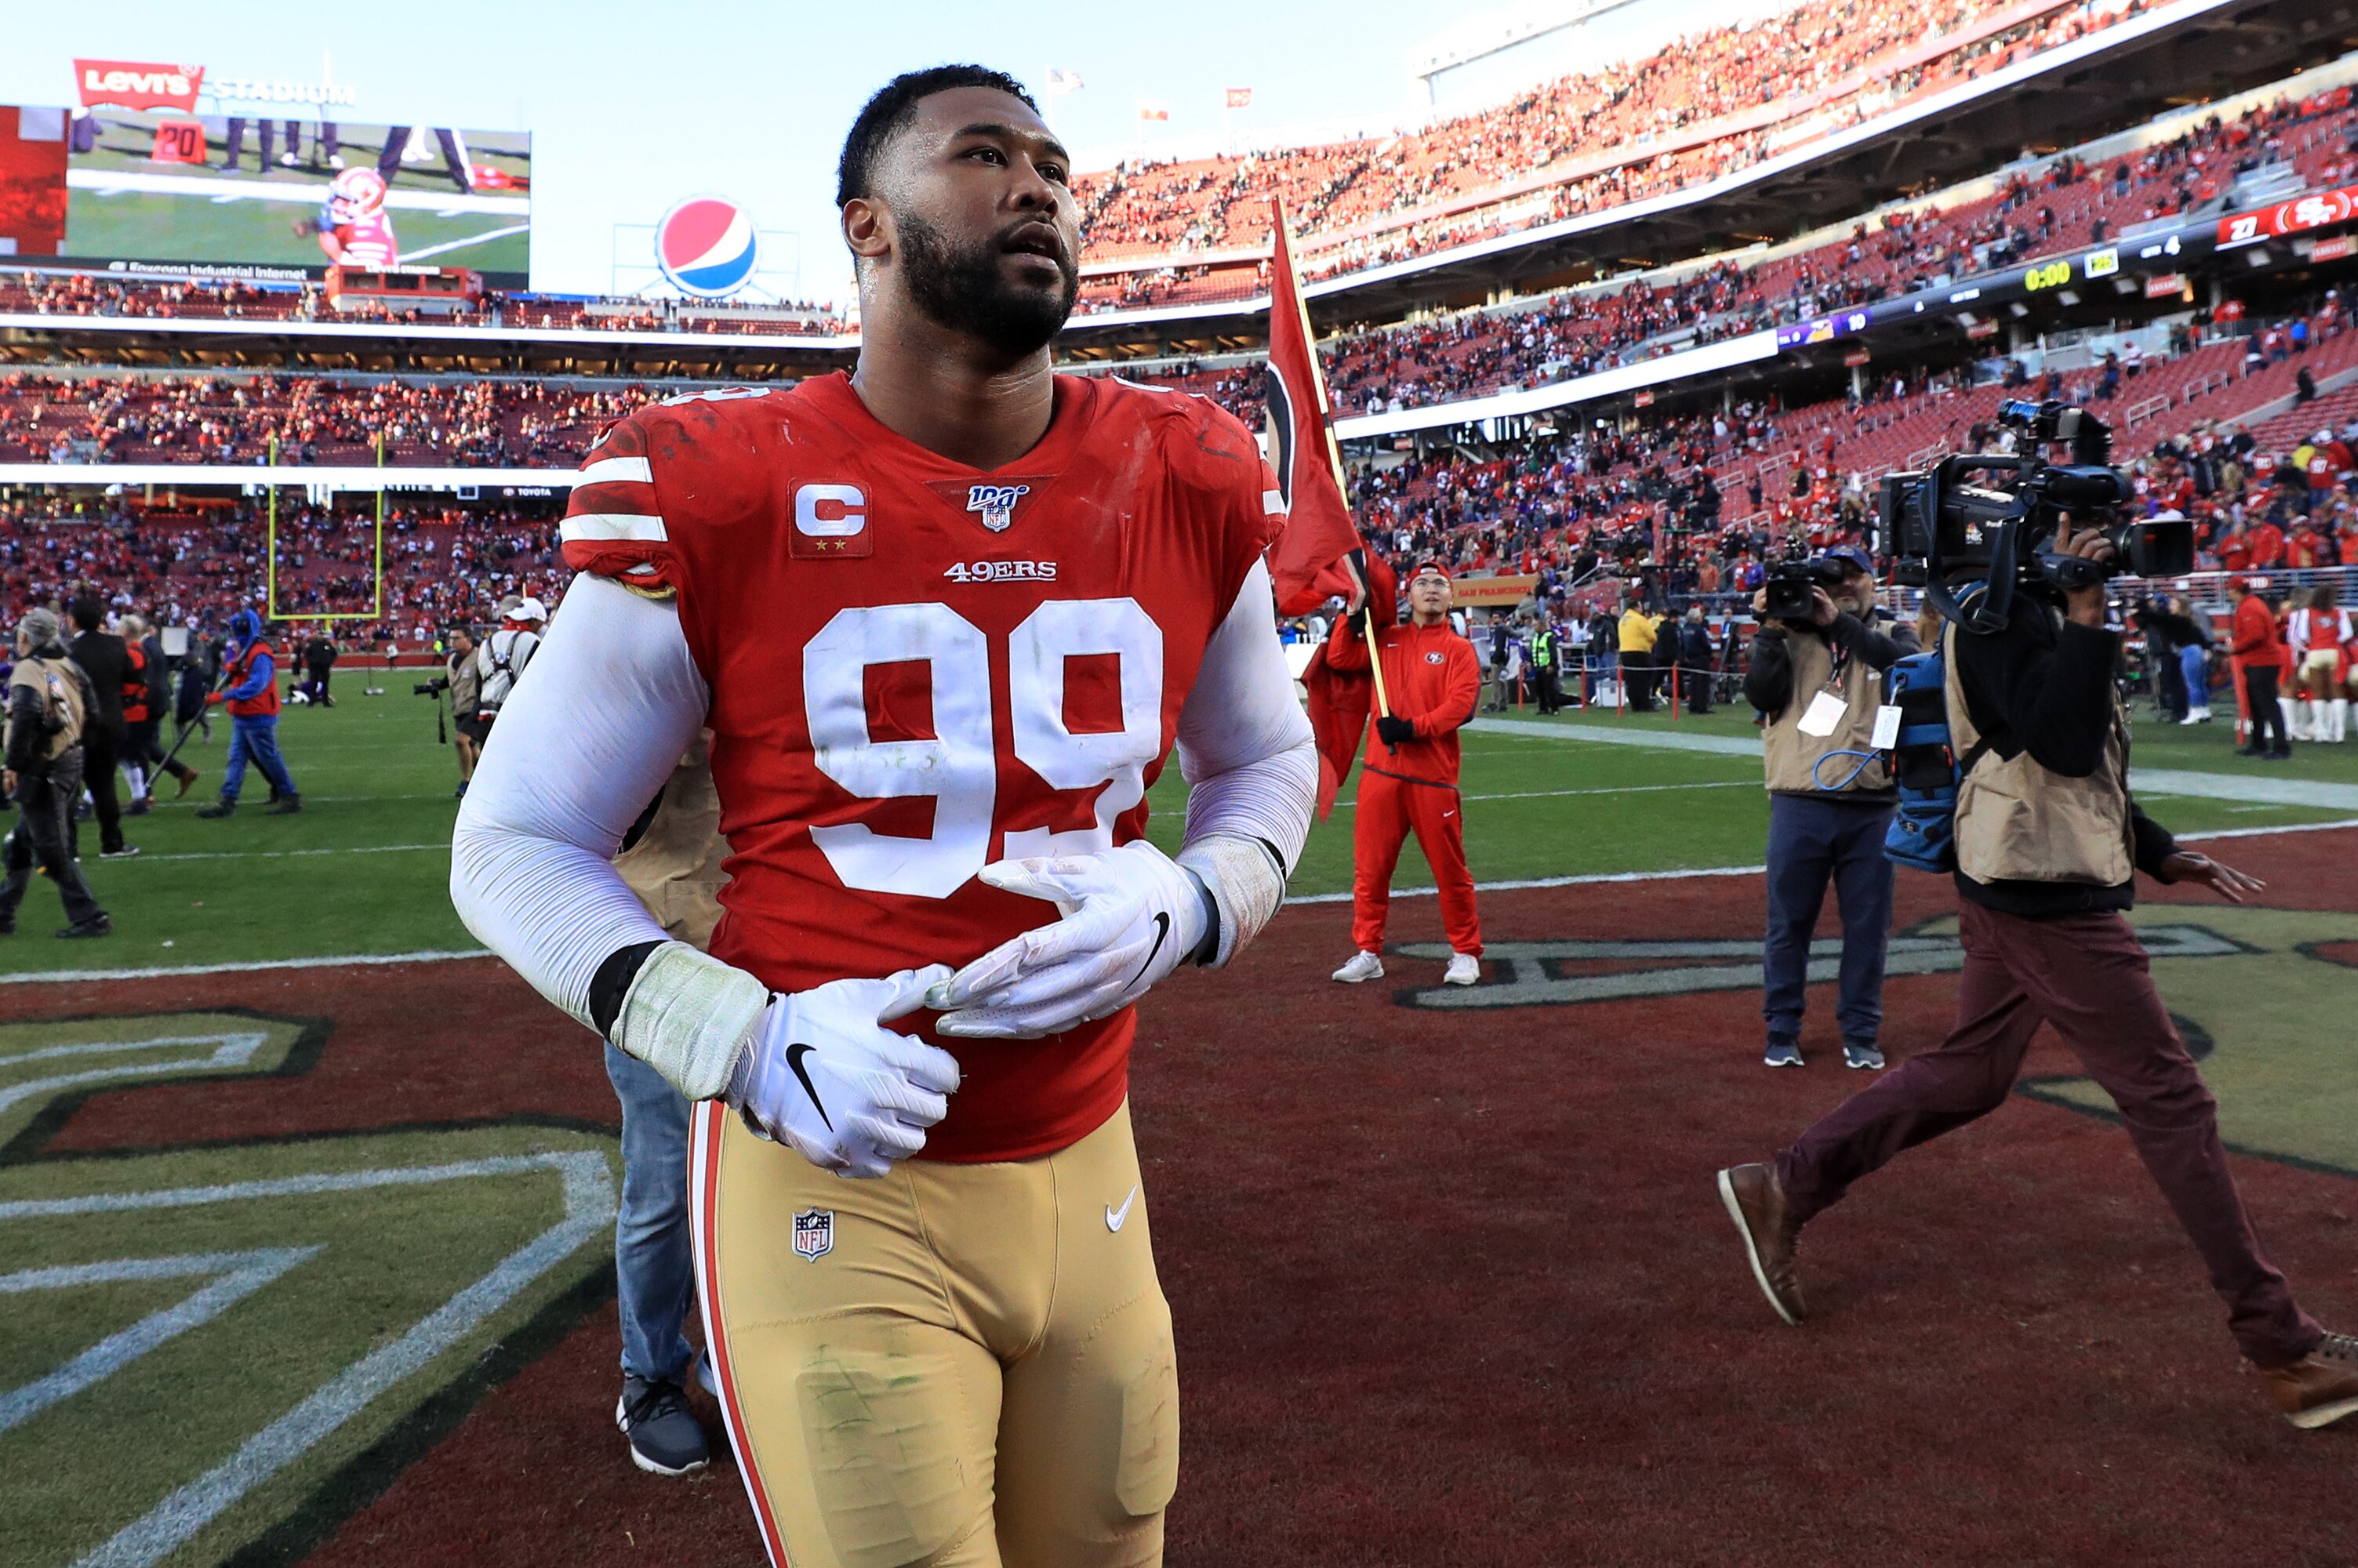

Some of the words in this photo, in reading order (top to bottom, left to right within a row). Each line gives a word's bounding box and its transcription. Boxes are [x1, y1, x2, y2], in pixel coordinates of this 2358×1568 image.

[213, 78, 354, 105] STADIUM
[163, 126, 197, 158] 20
[2229, 216, 2258, 241] 27
[2164, 235, 2181, 255] 4
[129, 261, 189, 274] Foxconn
[190, 263, 254, 277] Industrial
[255, 266, 307, 280] Internet
[2025, 261, 2070, 291] 0:00
[1848, 313, 1866, 331] 10
[518, 488, 551, 496] TOYOTA
[795, 484, 866, 536] C
[988, 514, 1005, 525] NFL
[943, 561, 1057, 583] 49ERS
[803, 597, 1164, 899] 99
[799, 1230, 827, 1251] NFL
